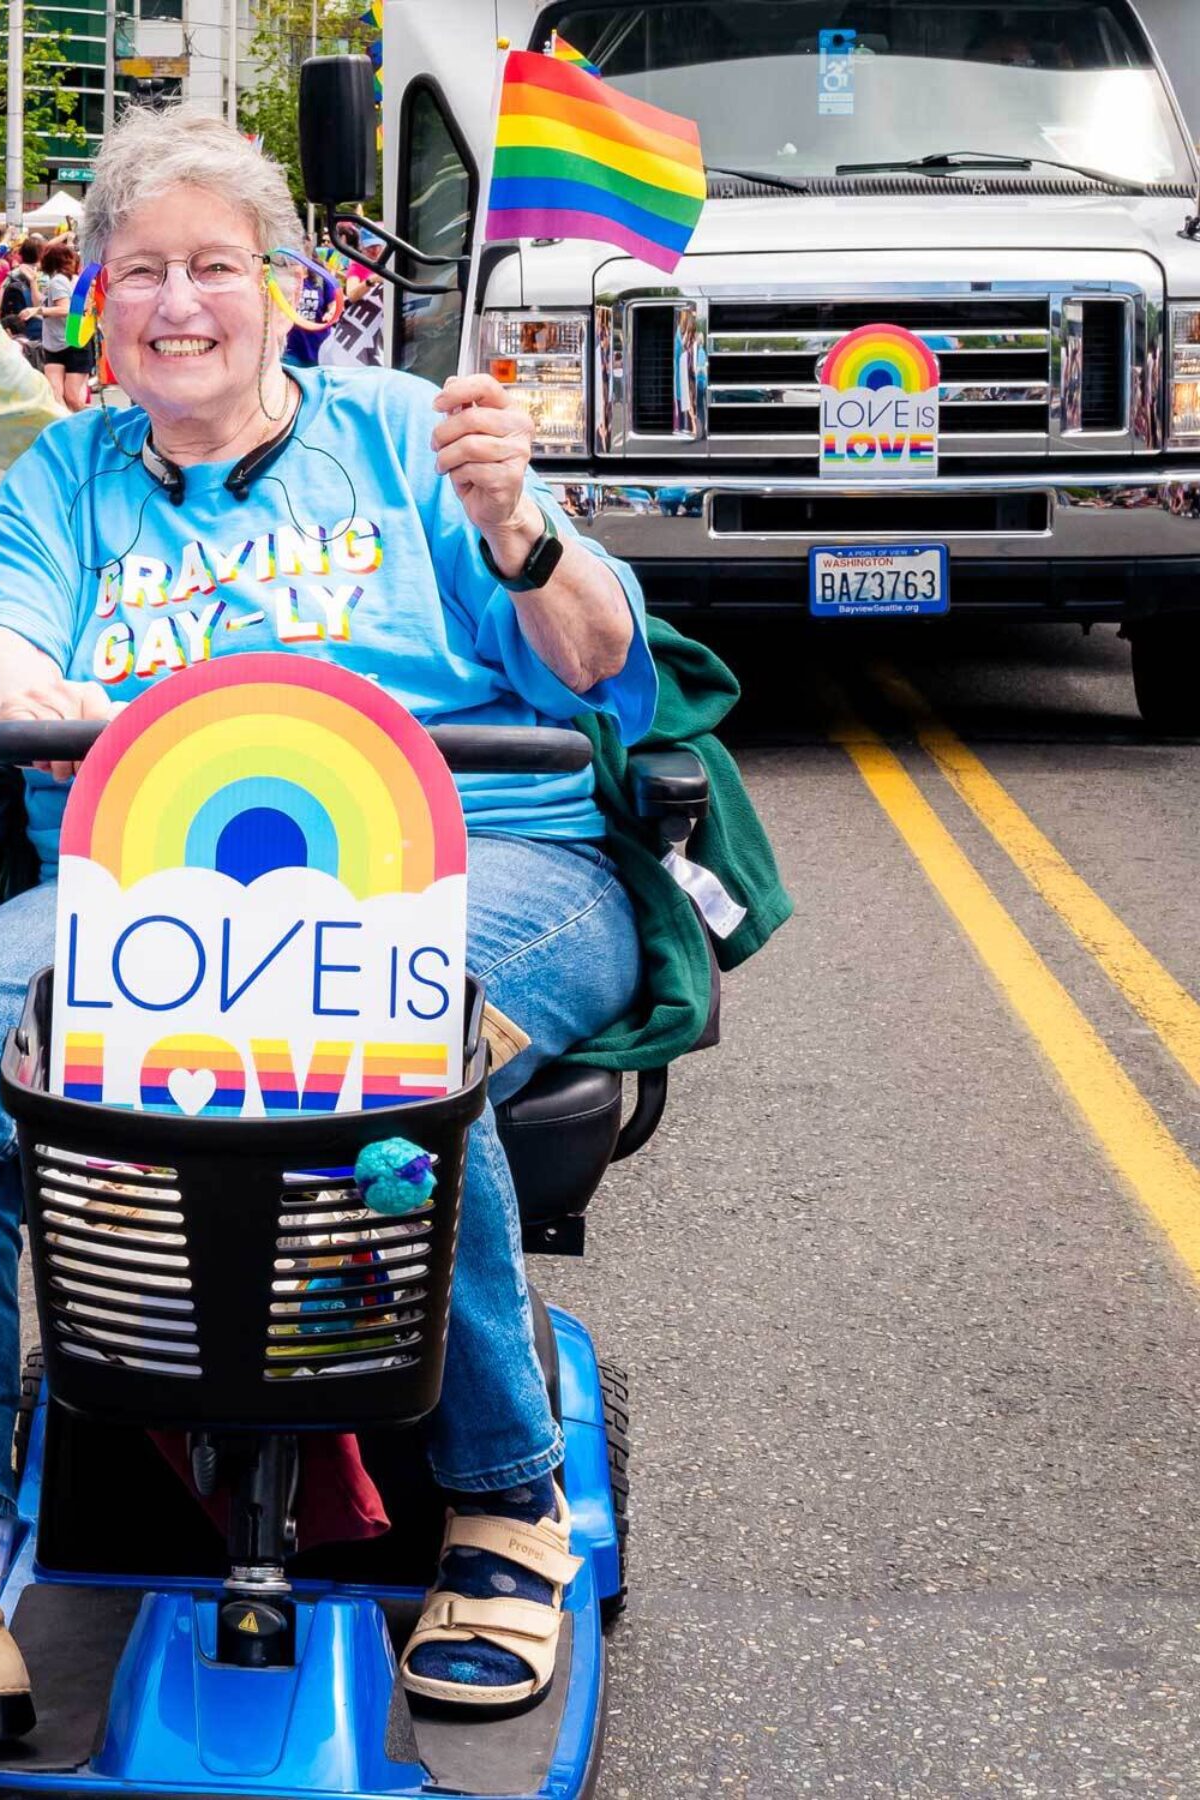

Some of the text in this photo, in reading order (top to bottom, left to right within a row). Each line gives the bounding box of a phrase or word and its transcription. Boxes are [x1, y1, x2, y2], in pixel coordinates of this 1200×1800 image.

[824, 400, 935, 428] LOVE IS
[824, 433, 934, 463] LOVE
[95, 517, 383, 618] GRAYING
[823, 558, 893, 568] WASHINGTON
[821, 570, 935, 602] BAZ3763
[839, 604, 919, 614] BayviewSeattle.org
[93, 586, 364, 684] GAY-LY
[67, 913, 450, 1020] LOVE IS
